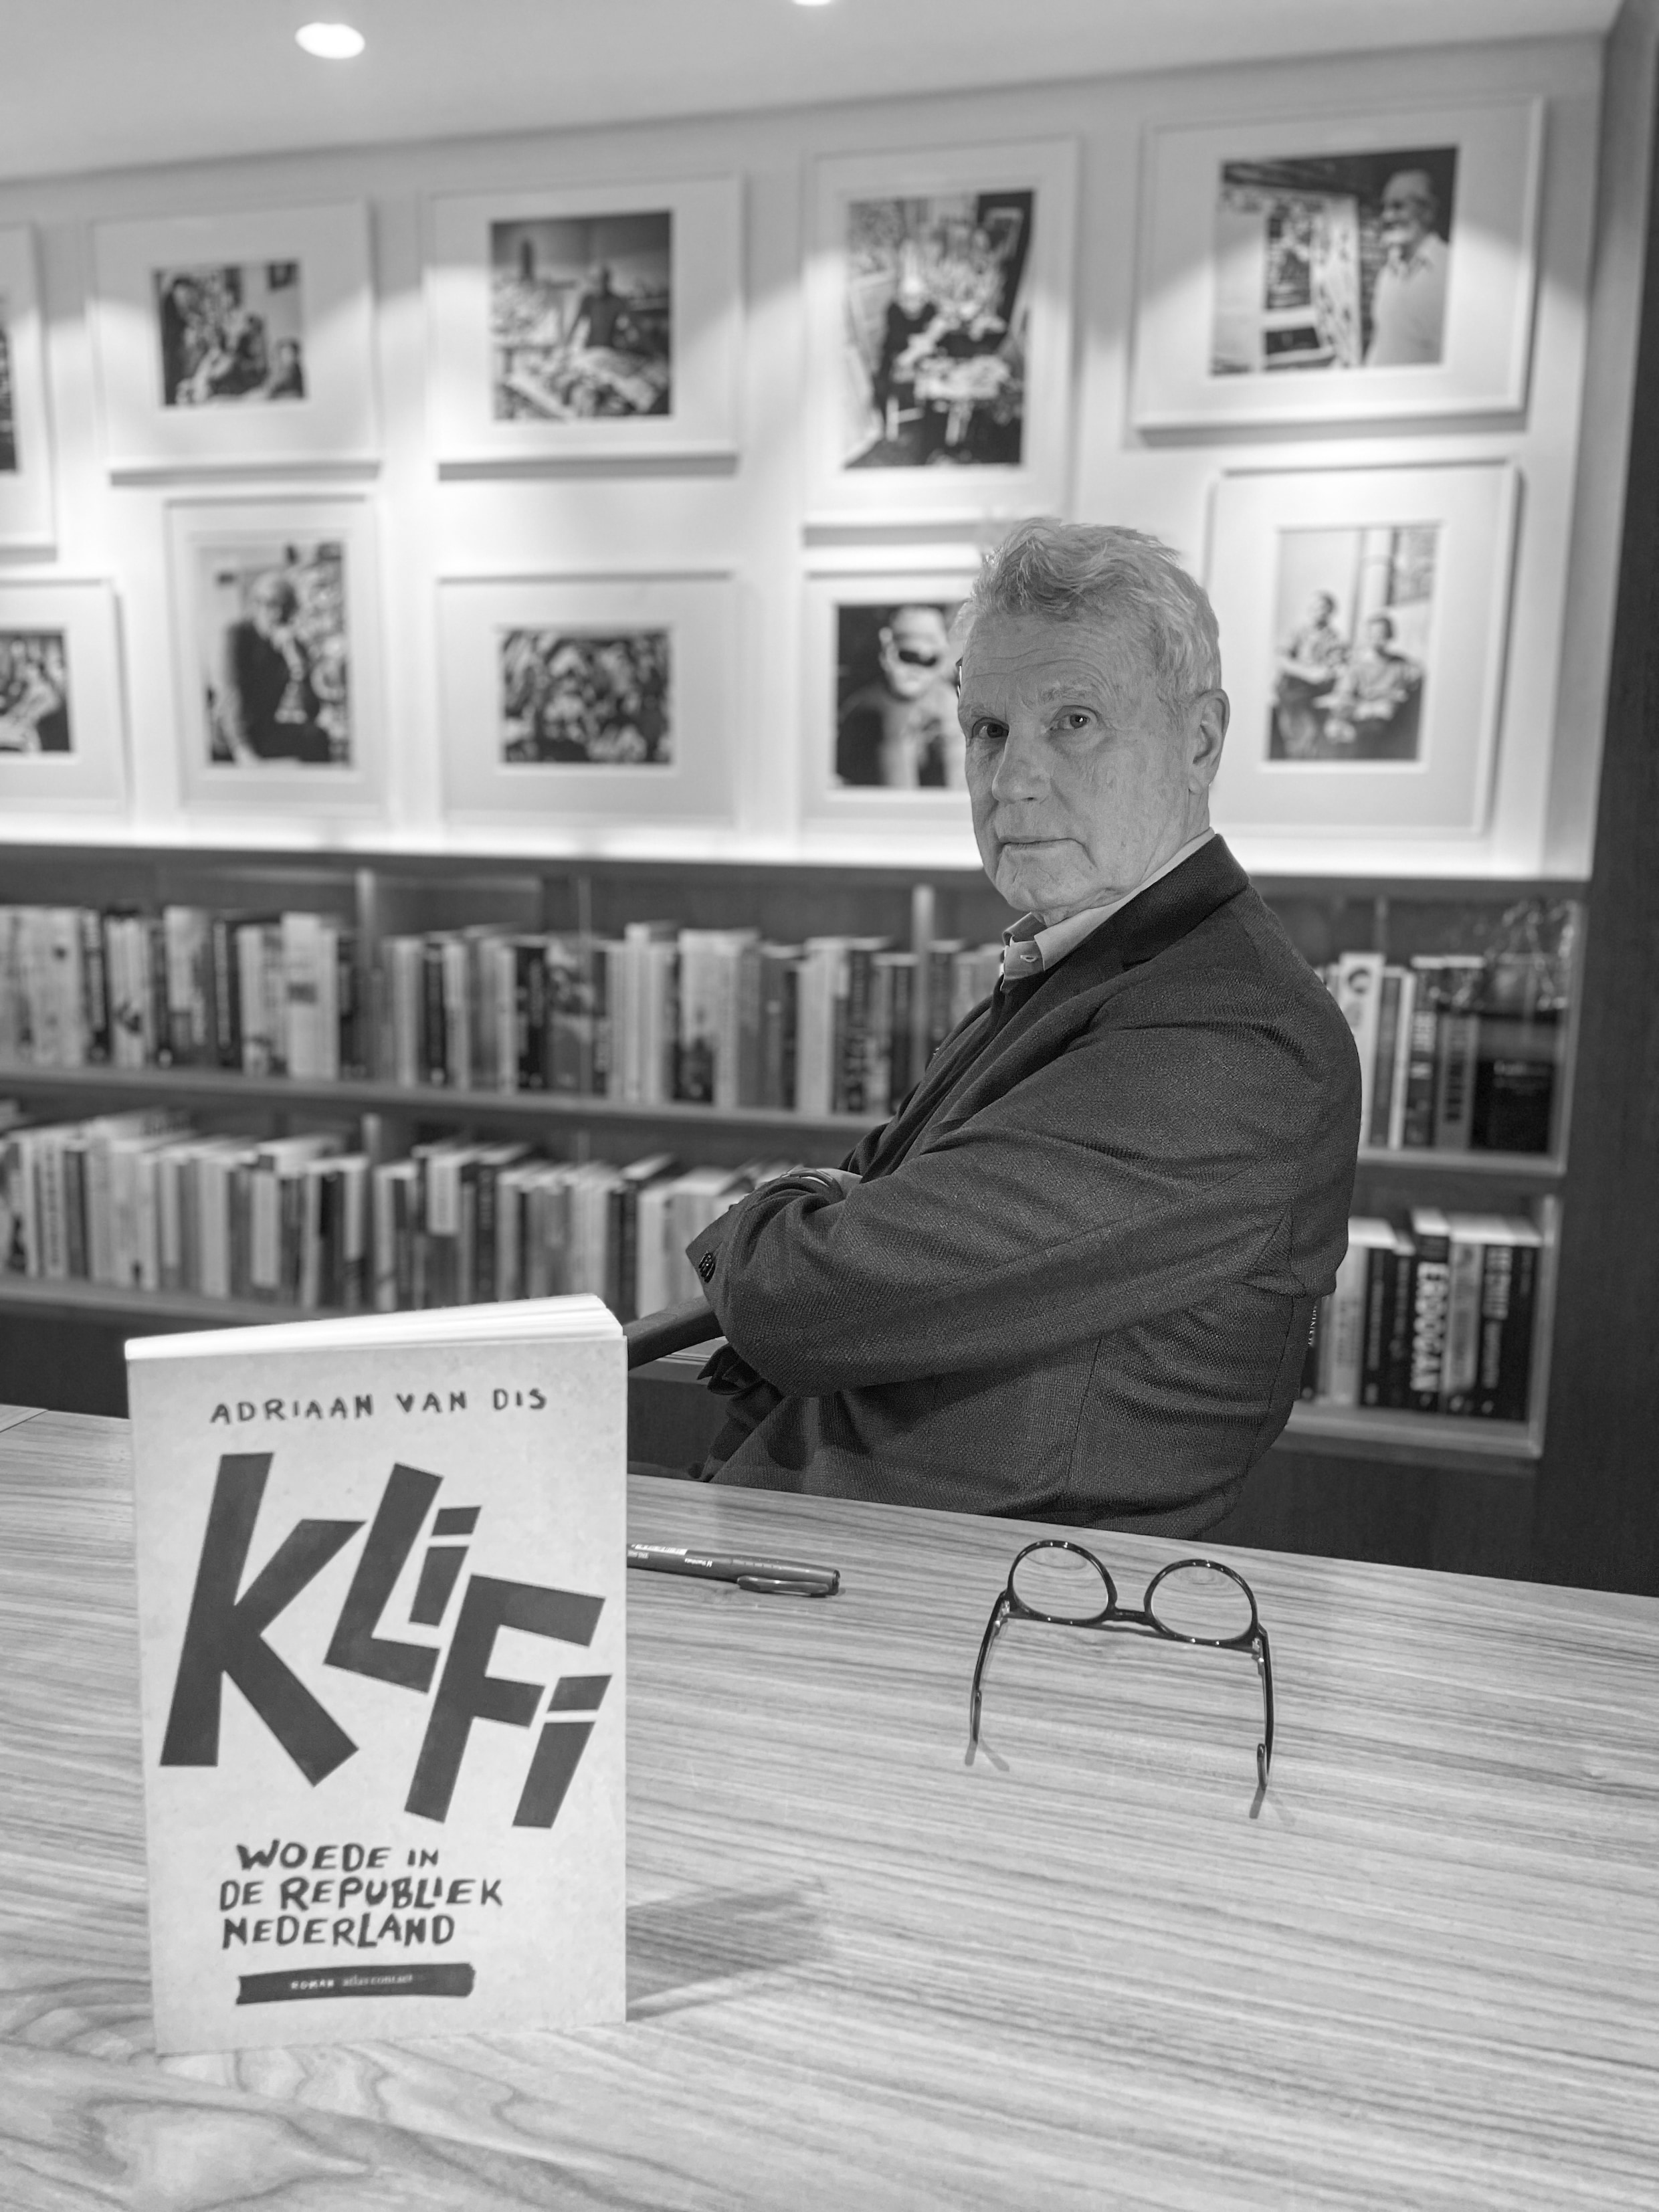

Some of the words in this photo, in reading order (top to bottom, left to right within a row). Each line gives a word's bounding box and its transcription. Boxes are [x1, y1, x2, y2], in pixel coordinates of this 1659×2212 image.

[210, 1394, 373, 1425] ADRIAAN
[395, 1391, 467, 1413] VAN
[492, 1388, 547, 1411] DIS
[235, 1838, 390, 1873] WOEDE
[407, 1849, 439, 1868] IN
[219, 1880, 262, 1912] DE
[280, 1876, 502, 1912] REPUBLIEK
[221, 1912, 455, 1950] NEDERLAND
